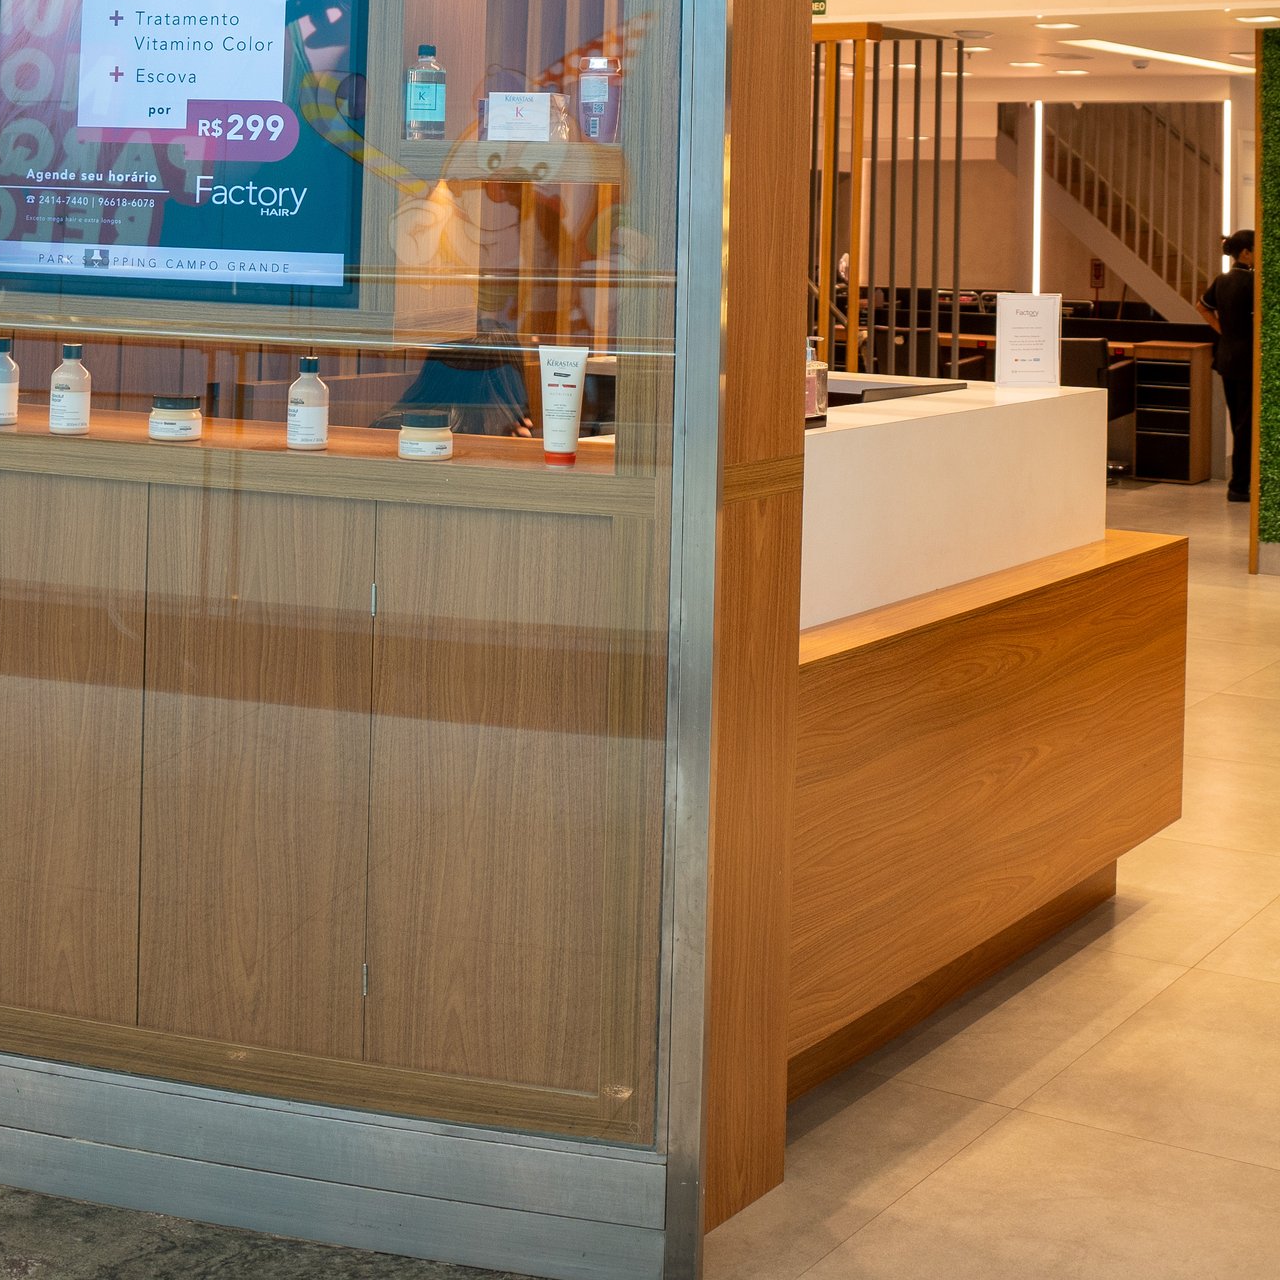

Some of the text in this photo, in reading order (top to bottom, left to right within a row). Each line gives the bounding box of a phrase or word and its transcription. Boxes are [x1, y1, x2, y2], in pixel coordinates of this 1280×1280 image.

[135, 11, 239, 26] Tratamento
[134, 36, 274, 52] Vitamino Color
[135, 69, 197, 84] Escova
[148, 104, 171, 118] por
[26, 169, 157, 183] Agende seu horário
[39, 195, 155, 208] 2414-7440 96618-6078
[195, 175, 307, 215] Factory
[260, 208, 289, 217] HAIR
[38, 254, 289, 273] PARK SOPPING CAMPO GRANDE
